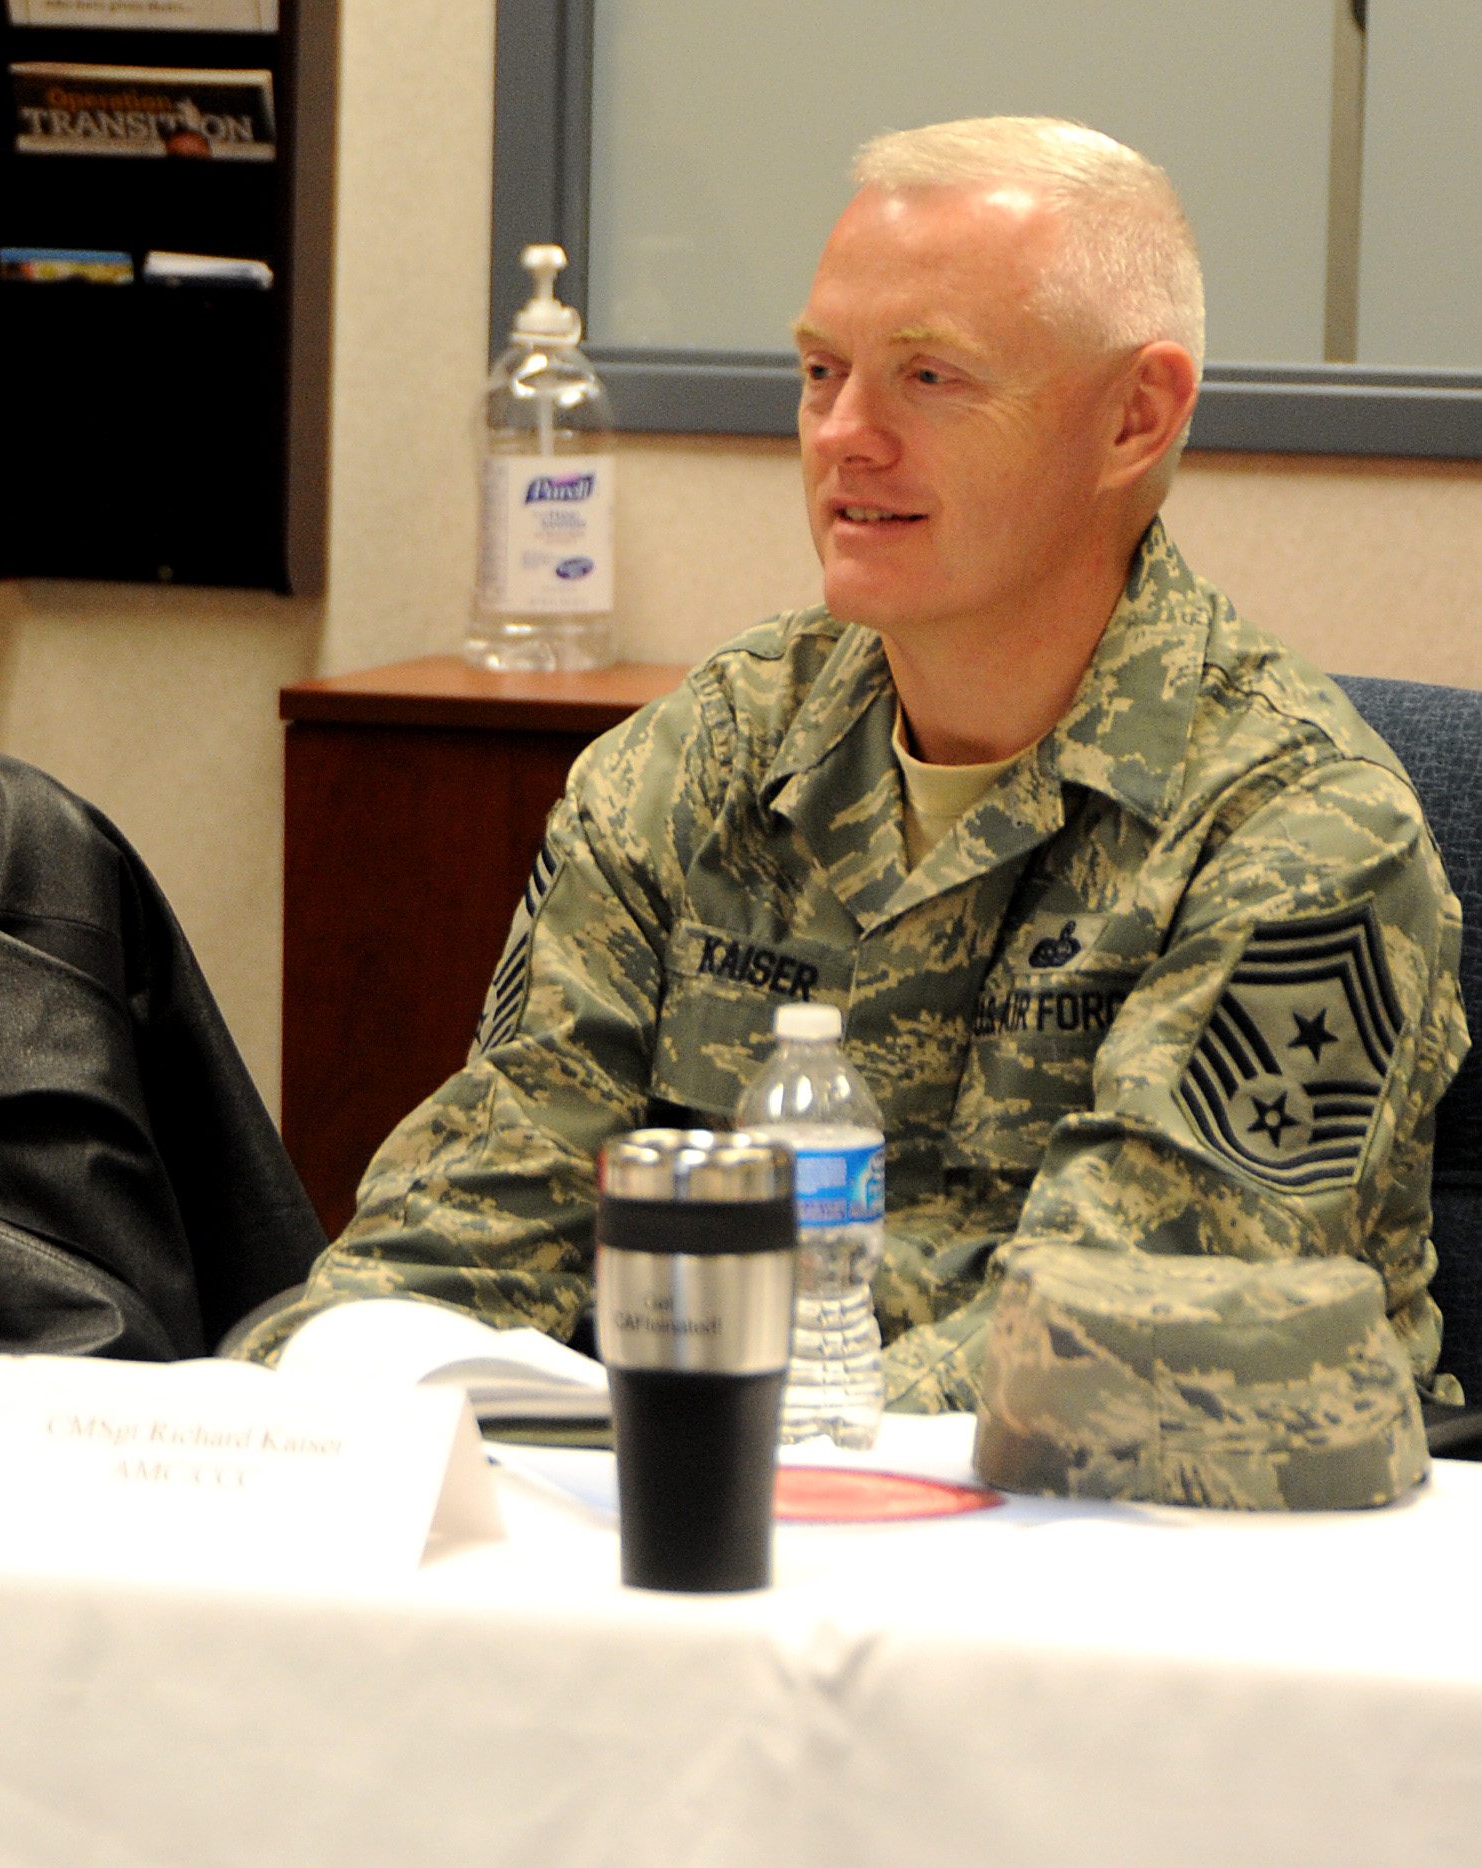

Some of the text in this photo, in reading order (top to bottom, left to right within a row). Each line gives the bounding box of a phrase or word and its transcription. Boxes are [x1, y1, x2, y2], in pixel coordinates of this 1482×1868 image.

[698, 935, 819, 1003] KAISER
[1035, 990, 1129, 1032] FORC
[44, 1413, 346, 1458] CMSgt Richard Kaiser
